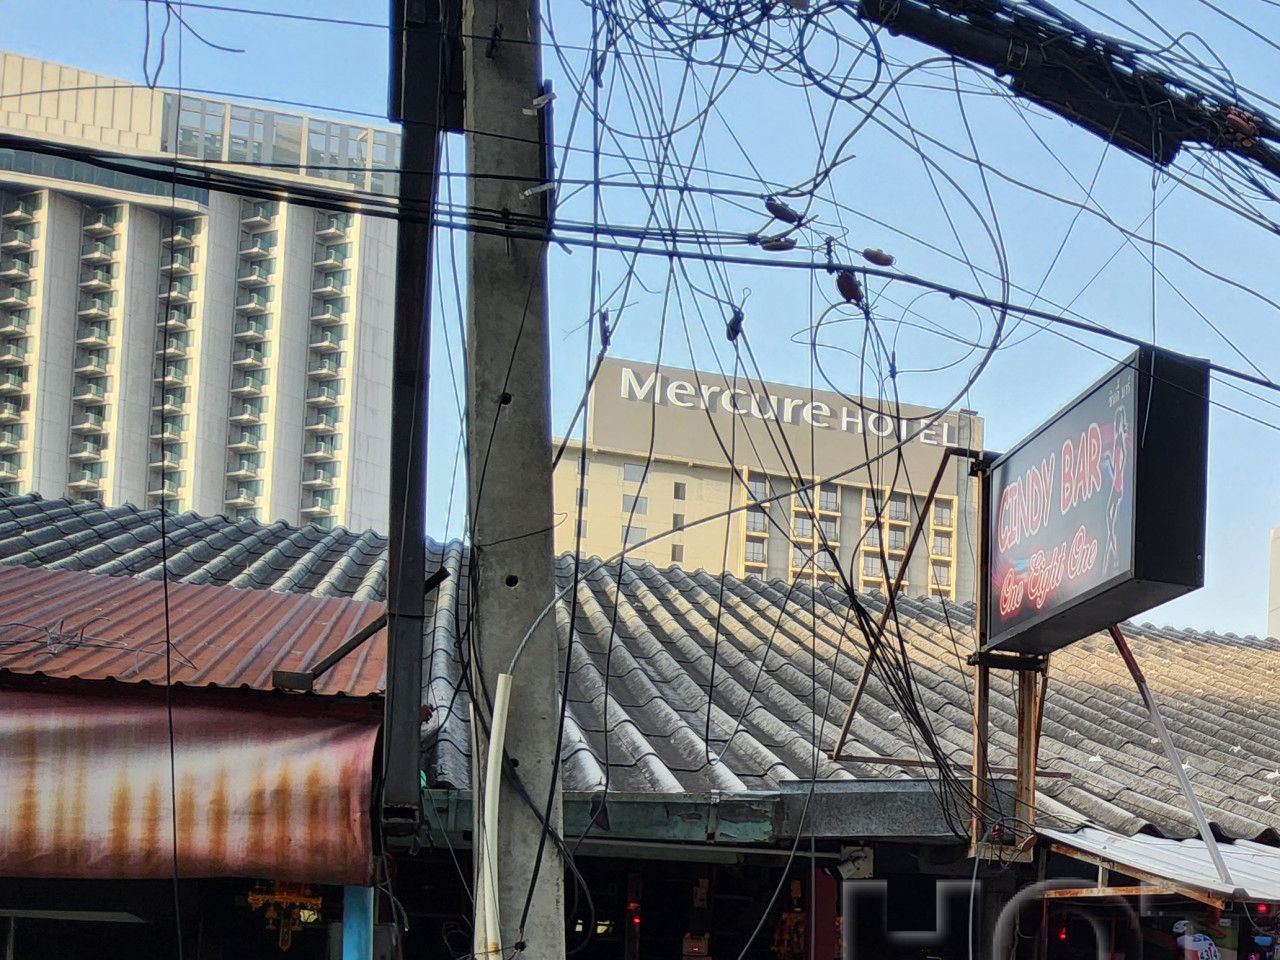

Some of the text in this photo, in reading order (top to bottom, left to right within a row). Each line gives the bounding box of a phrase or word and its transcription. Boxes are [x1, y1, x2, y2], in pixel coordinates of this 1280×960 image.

[619, 367, 959, 447] Mercure HOTEL
[997, 422, 1103, 554] CINDY BAR
[999, 525, 1099, 616] One Eight One
